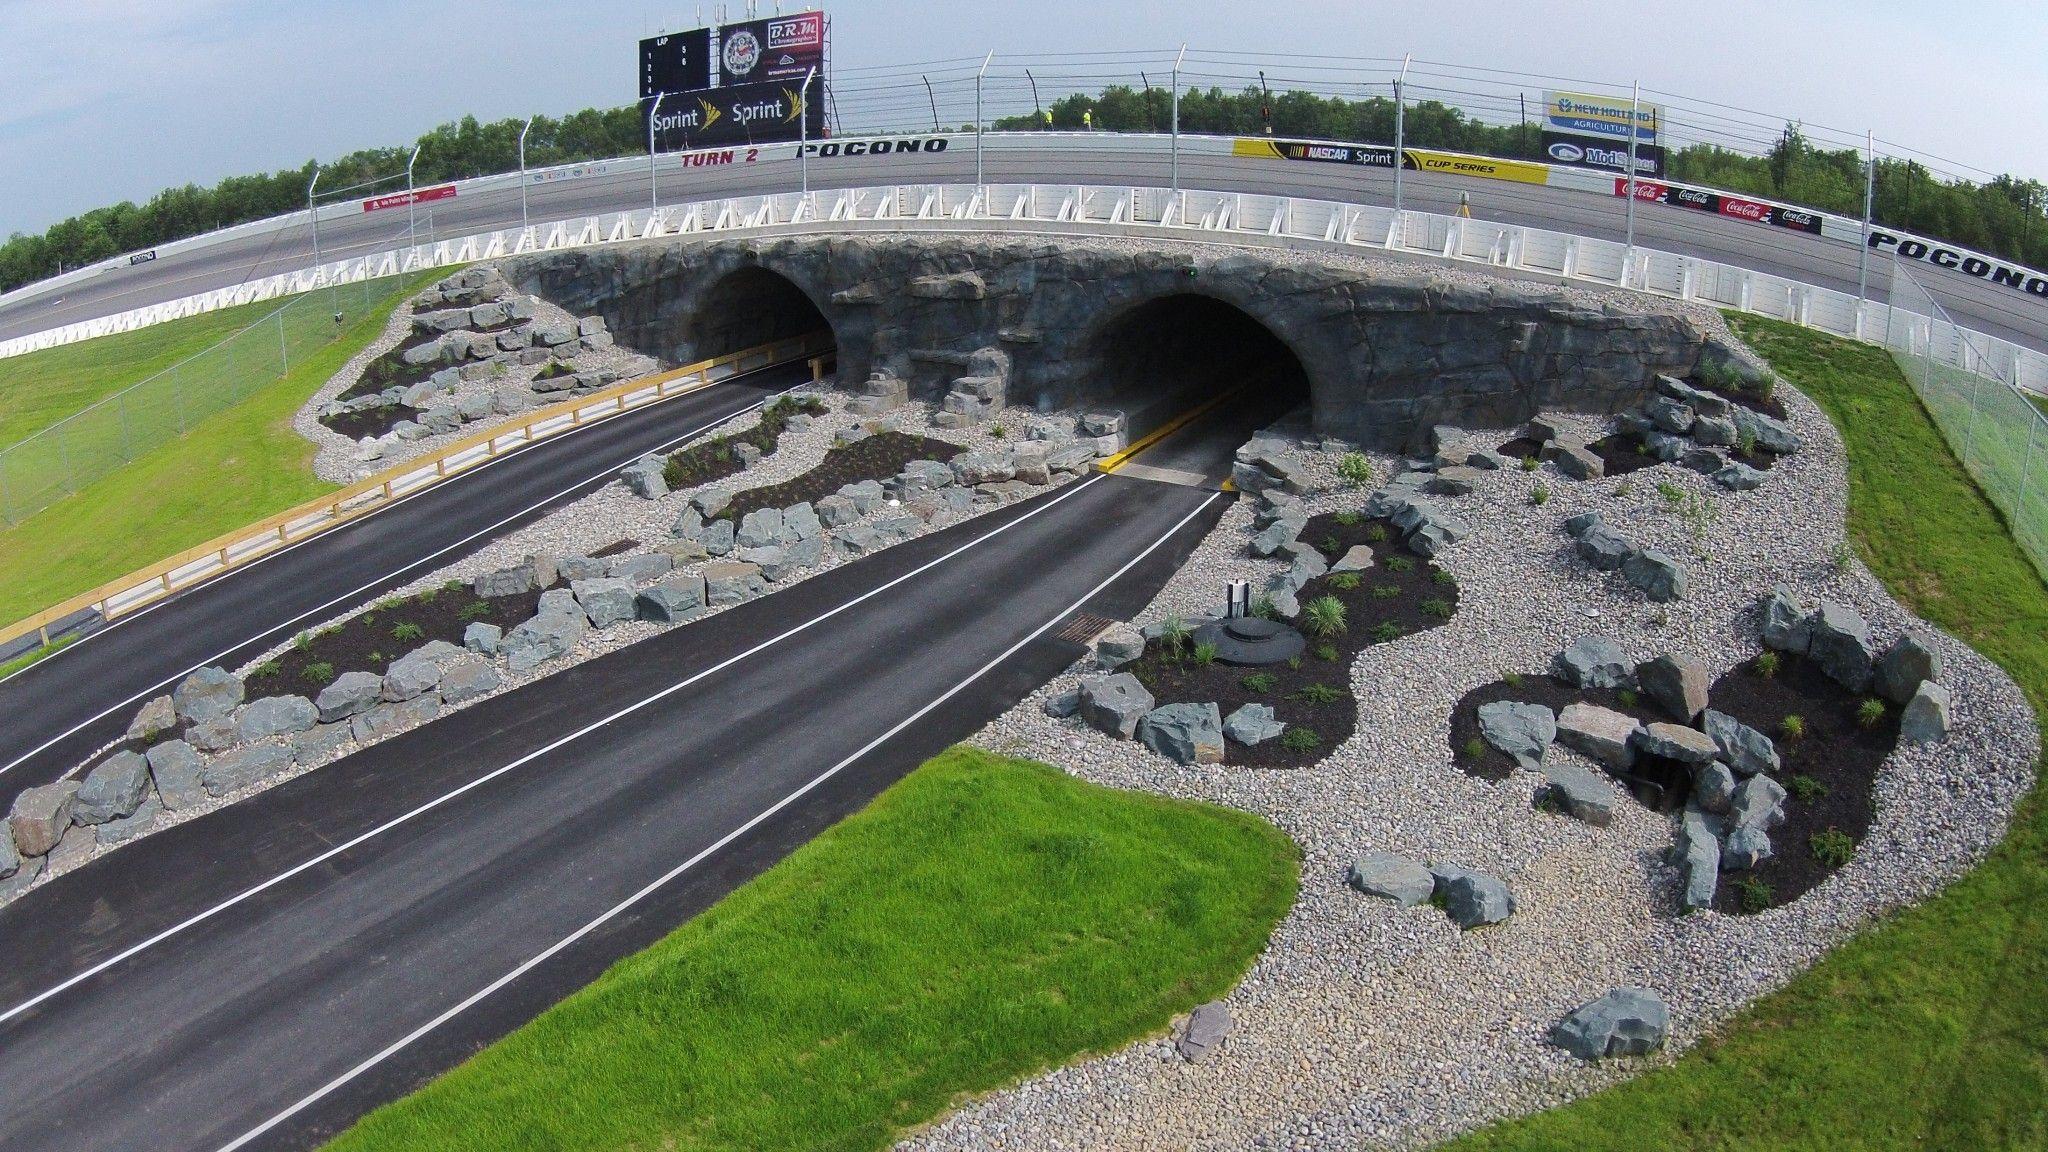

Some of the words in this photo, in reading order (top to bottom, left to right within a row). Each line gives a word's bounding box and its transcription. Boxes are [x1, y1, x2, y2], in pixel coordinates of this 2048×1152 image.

[657, 37, 669, 46] LAP
[682, 46, 687, 54] 5
[647, 64, 652, 72] 2
[682, 58, 687, 66] 6
[654, 109, 698, 131] Sprint
[733, 99, 783, 125] Sprint
[1574, 103, 1600, 115] NEW
[1601, 107, 1650, 122] HOLLAND
[796, 138, 949, 159] POCONO
[682, 150, 735, 168] TURN
[746, 149, 758, 163] 2
[1307, 145, 1348, 161] NASCAR
[1356, 150, 1392, 166] Sprint
[1426, 159, 1451, 169] CUP
[1453, 161, 1497, 174] SERIES
[1868, 231, 2048, 298] POCONO
